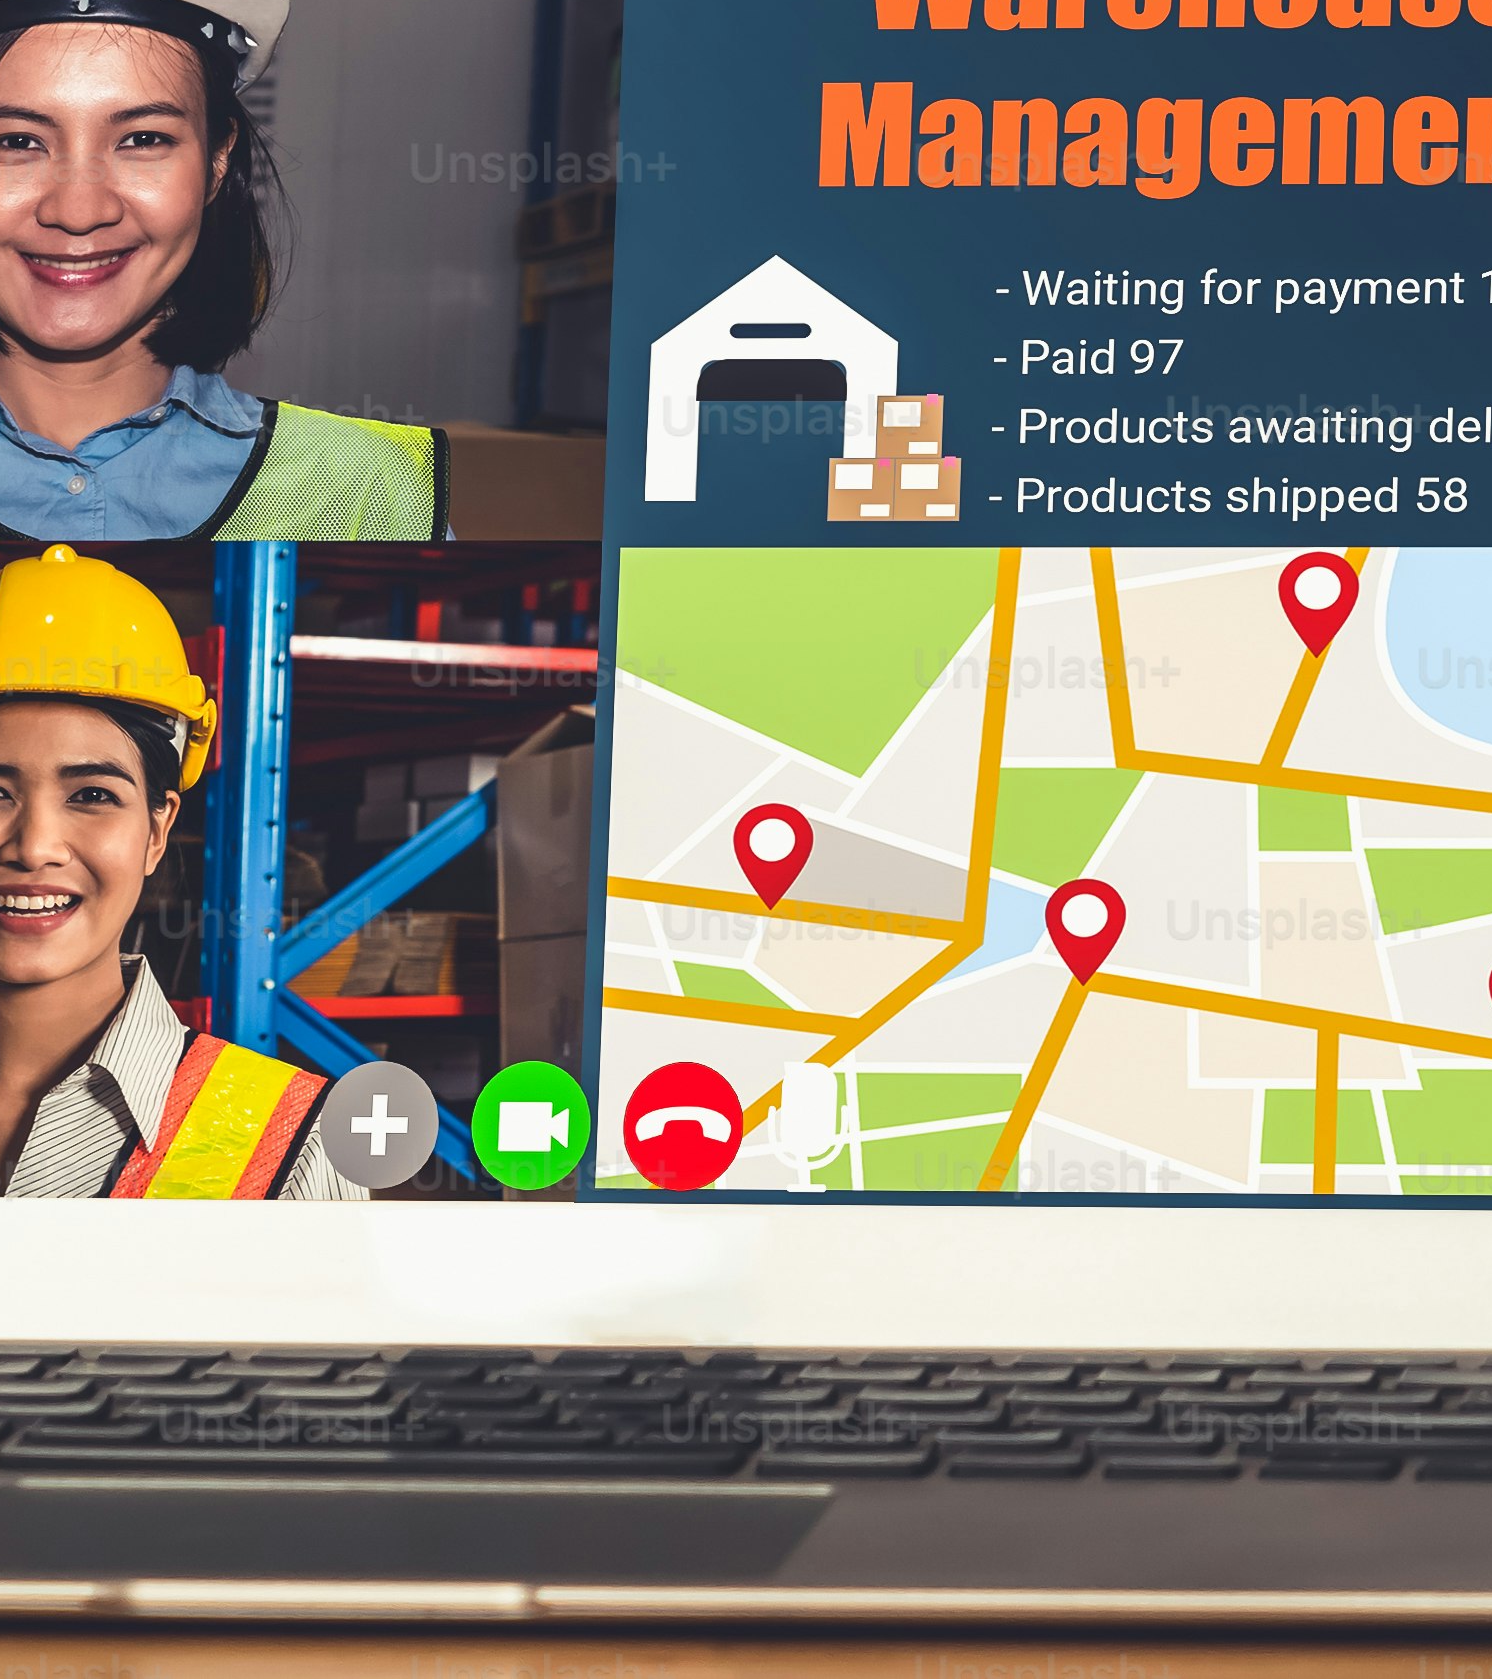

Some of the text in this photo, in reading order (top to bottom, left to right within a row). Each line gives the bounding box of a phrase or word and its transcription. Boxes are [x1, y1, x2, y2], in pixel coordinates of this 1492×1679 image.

[1022, 268, 1184, 315] Waiting
[1200, 267, 1262, 305] for
[1275, 272, 1465, 315] payment
[1021, 338, 1115, 375] Paid
[1130, 339, 1184, 375] 97
[1019, 407, 1214, 444] Products
[1228, 406, 1413, 453] awaiting
[1017, 477, 1212, 513] Products
[1226, 476, 1399, 522] shipped
[1416, 477, 1468, 513] 58
